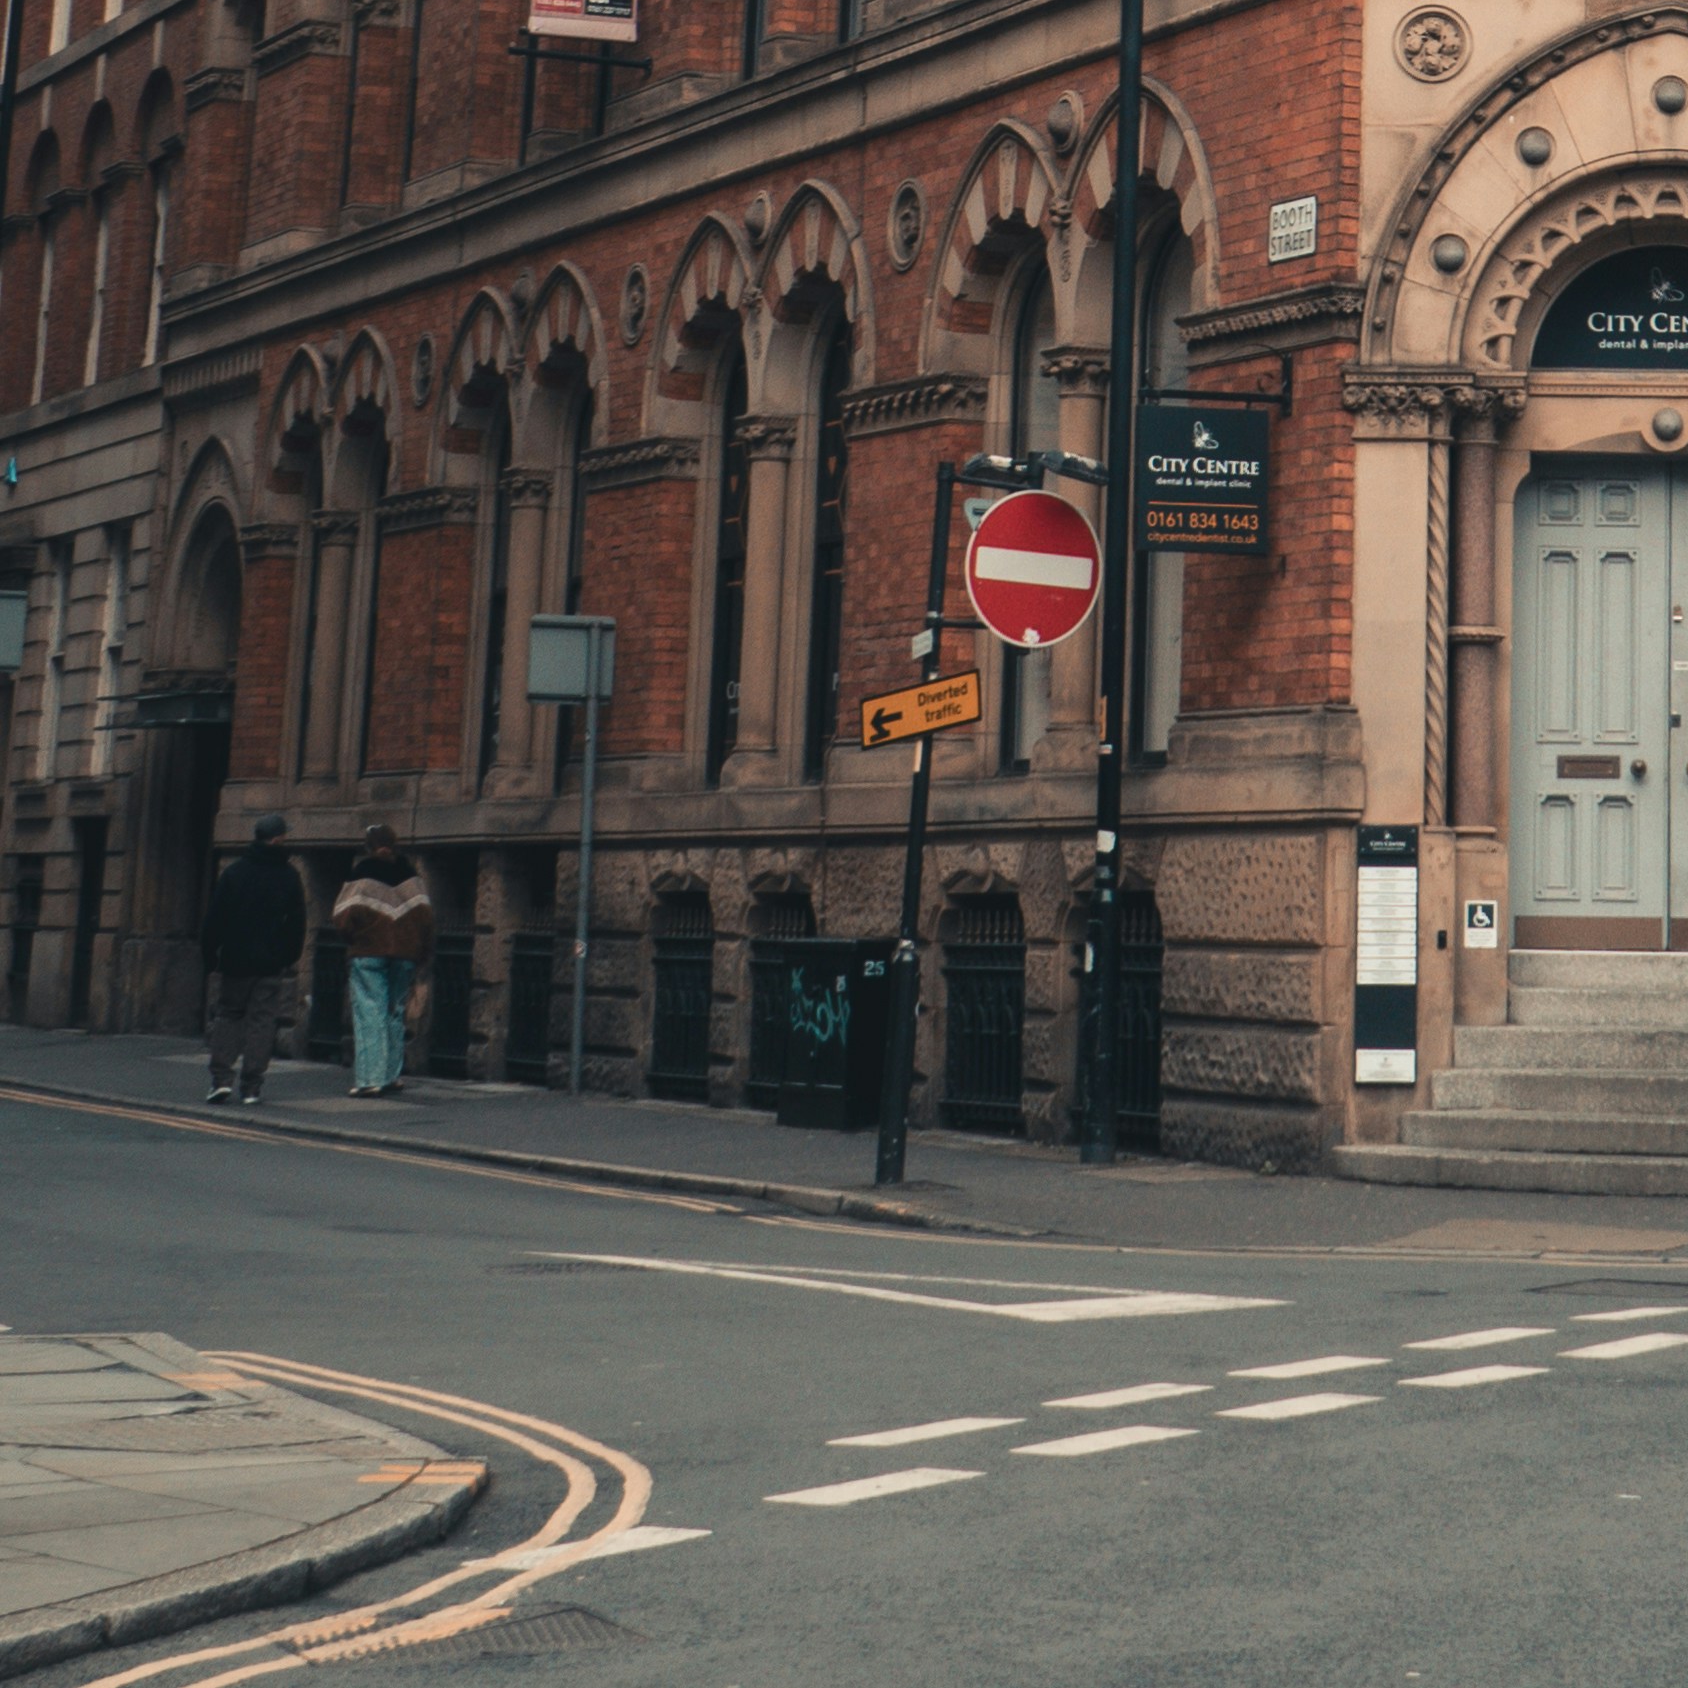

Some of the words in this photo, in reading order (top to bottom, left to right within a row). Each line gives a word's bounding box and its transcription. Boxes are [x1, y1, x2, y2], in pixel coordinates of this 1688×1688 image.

[1272, 203, 1313, 231] BOOTH
[1271, 228, 1313, 256] STREET
[1598, 339, 1636, 349] dental
[1640, 339, 1648, 349] &
[1156, 477, 1183, 486] dental
[1186, 478, 1192, 486] &
[1194, 478, 1227, 489] implant
[1229, 479, 1252, 488] clinic
[1147, 511, 1183, 528] 0161
[1190, 512, 1217, 528] 834
[1223, 514, 1259, 531] 1643
[1147, 530, 1257, 543] citycentredentist.co.uk
[918, 682, 968, 707] Diverted
[925, 703, 962, 722] traffic
[864, 960, 885, 976] 25
